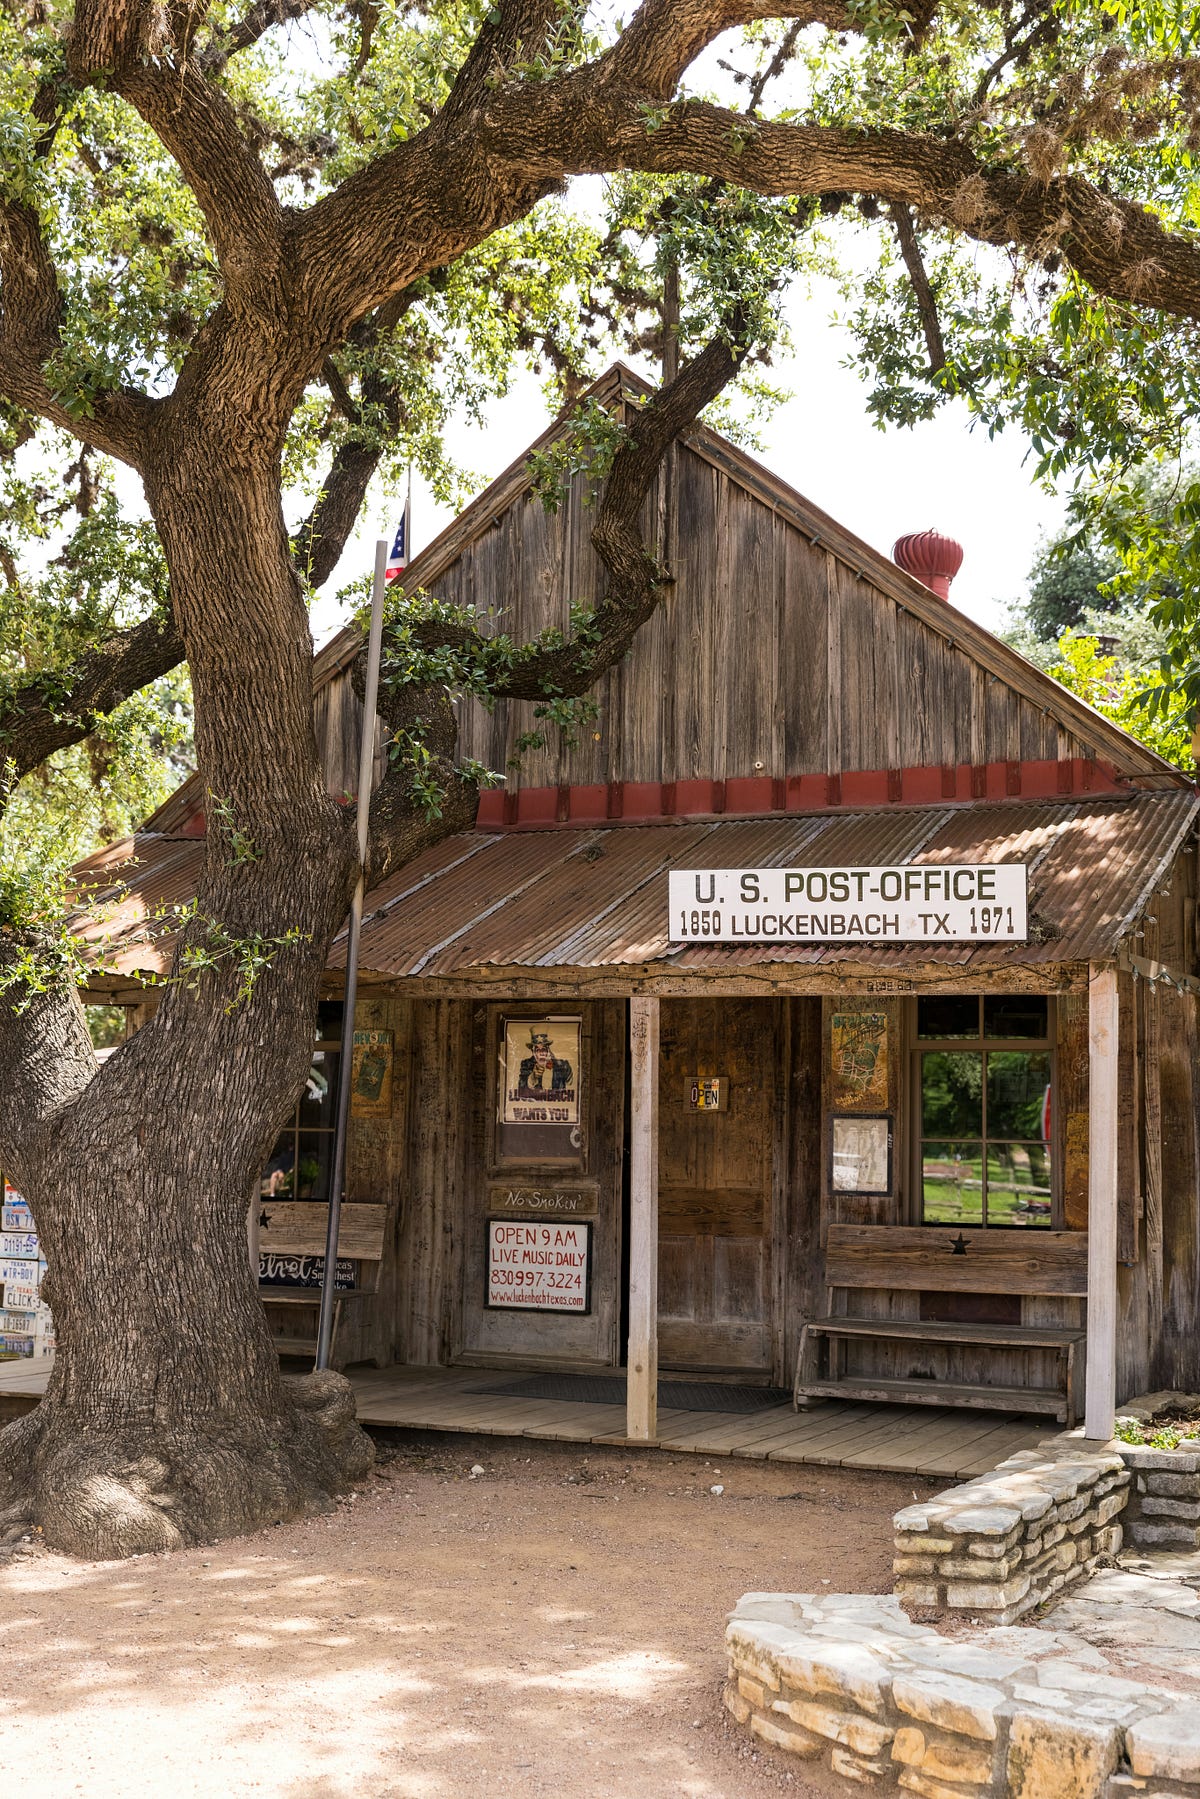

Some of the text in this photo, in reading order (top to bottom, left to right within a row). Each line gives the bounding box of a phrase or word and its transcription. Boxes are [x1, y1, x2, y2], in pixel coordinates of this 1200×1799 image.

[695, 869, 997, 903] U. S. POST-OFFICE
[681, 906, 1015, 936] 1850 LUCKENBACH TX. 1971
[691, 1087, 718, 1105] OPEN
[512, 1107, 569, 1121] WANTS YOU
[494, 1226, 578, 1248] OPEN 9 AM
[491, 1247, 586, 1267] LIVE MUSIC DAILY
[16, 1286, 33, 1295] TEXAS
